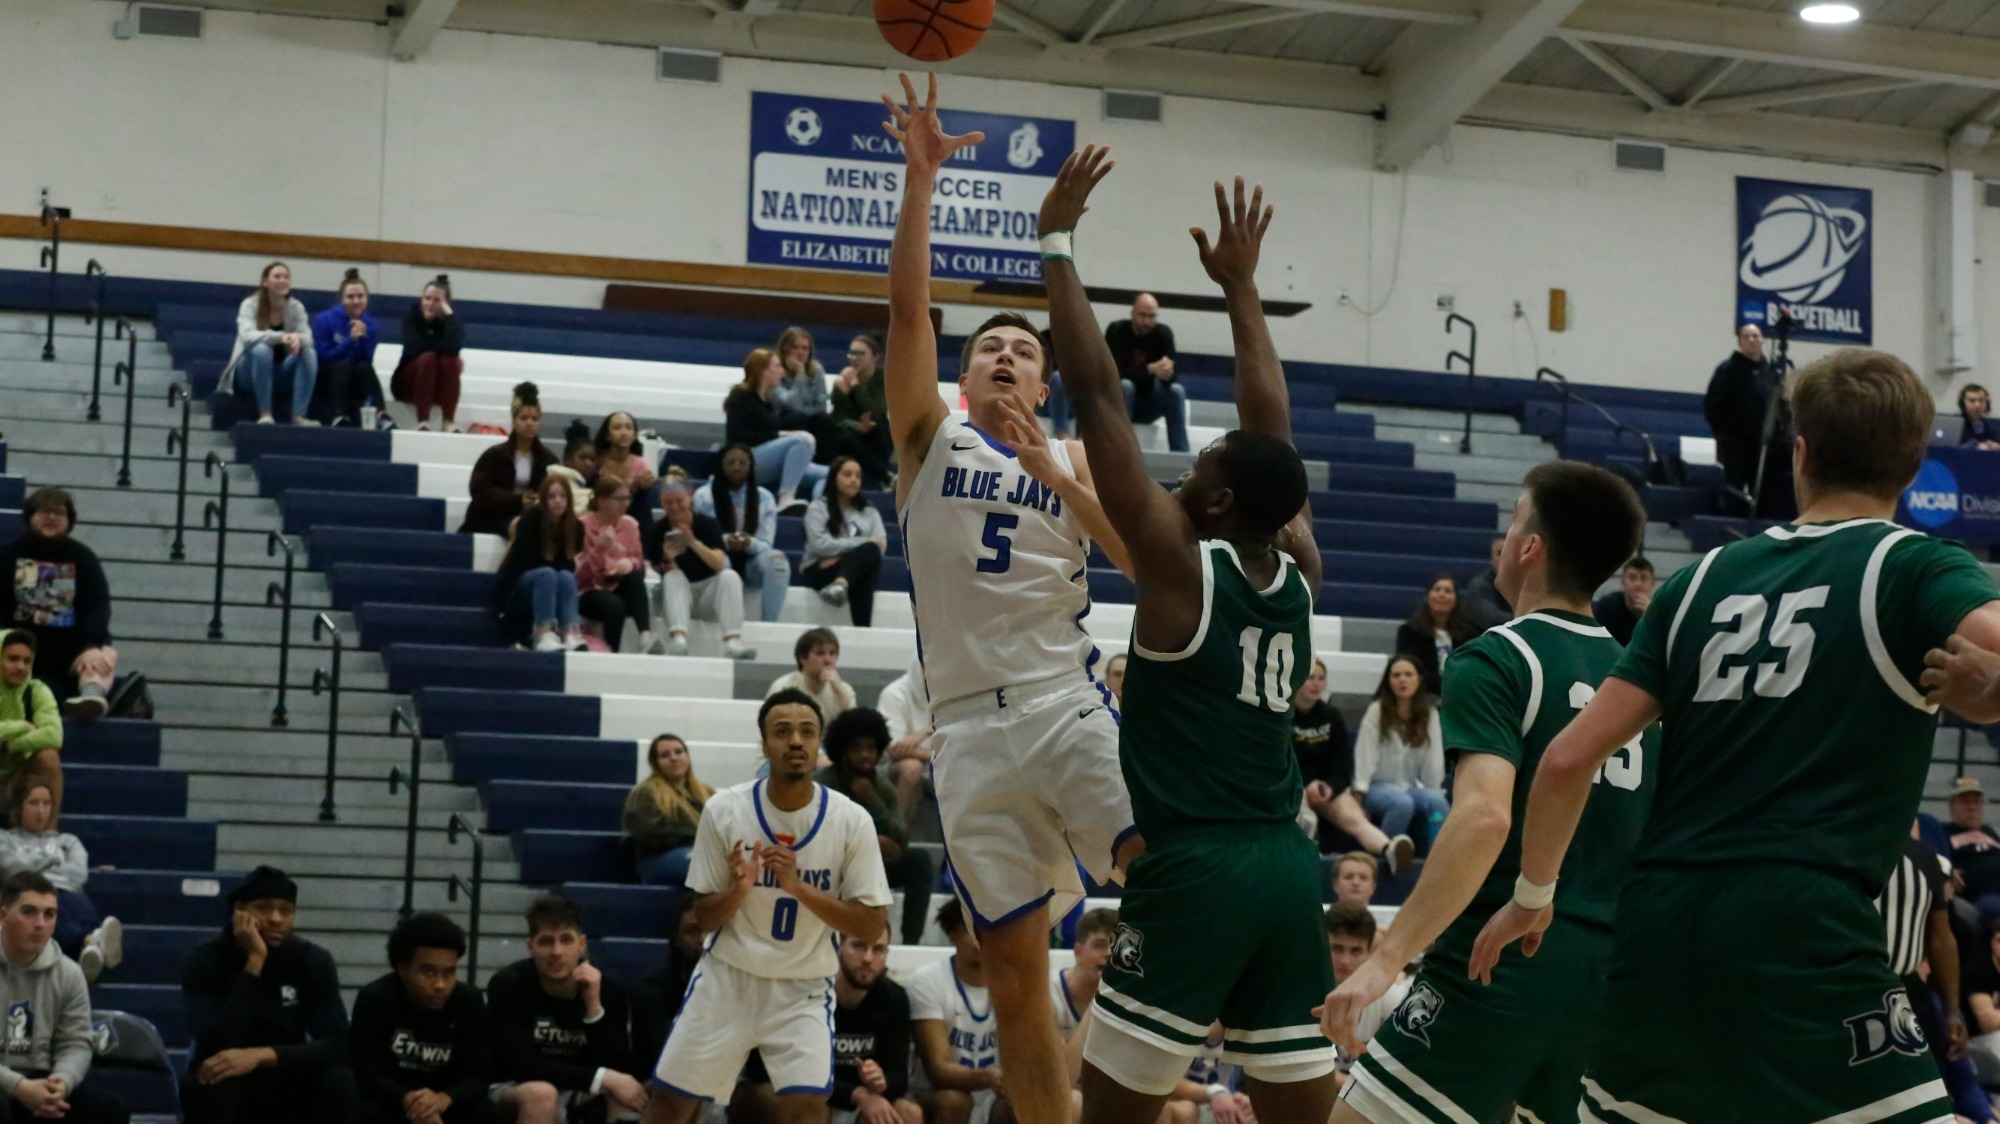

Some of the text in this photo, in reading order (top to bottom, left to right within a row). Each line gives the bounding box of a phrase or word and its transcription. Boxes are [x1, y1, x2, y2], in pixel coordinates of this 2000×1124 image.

[825, 167, 1002, 201] MEN'S CCER
[760, 189, 900, 230] NATIONAL
[951, 253, 1043, 278] COLLEGE
[941, 467, 1003, 501] BLUE
[976, 512, 1019, 574] 5
[1692, 585, 1831, 702] 25
[1236, 625, 1295, 713] 10
[996, 688, 1008, 709] E
[796, 868, 831, 891] AYS
[771, 896, 799, 942] 0
